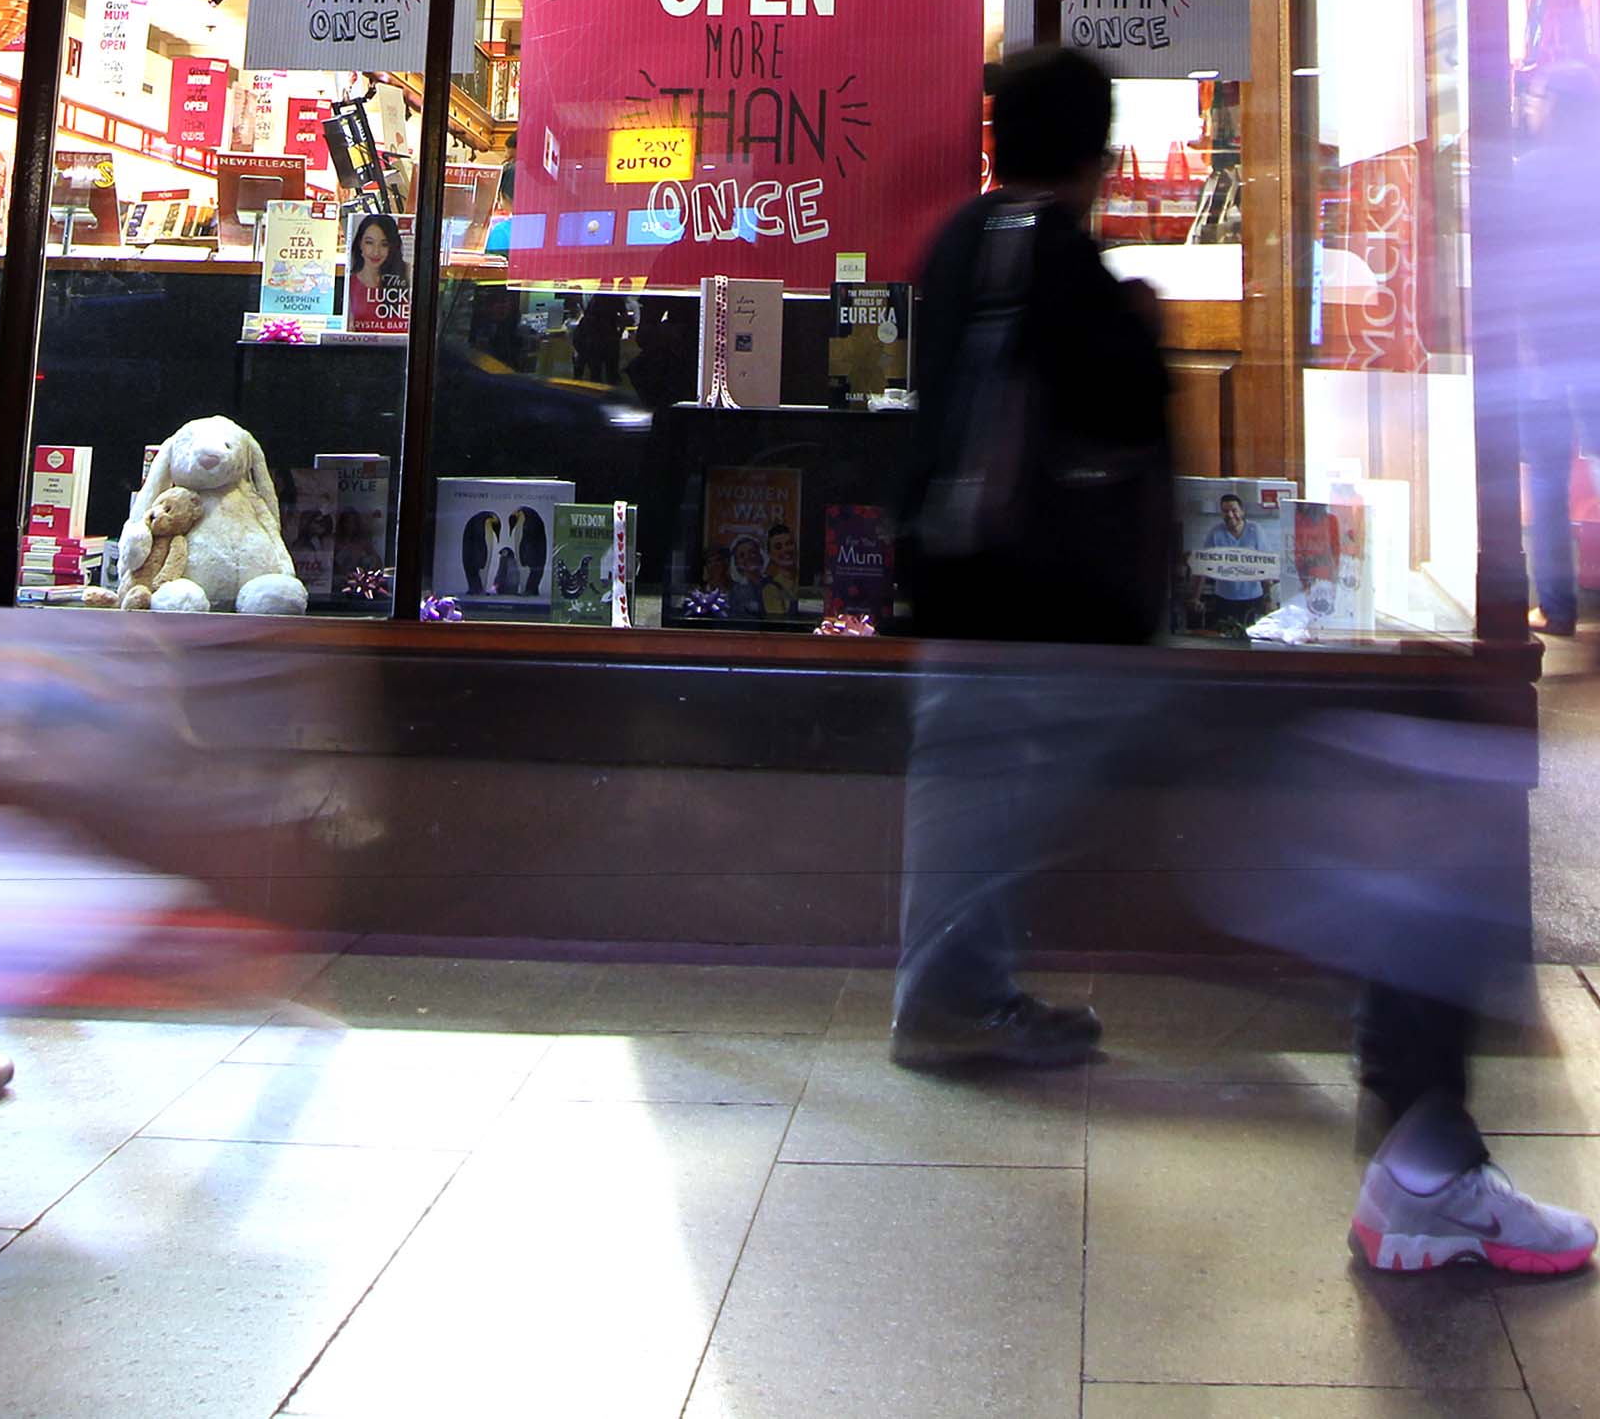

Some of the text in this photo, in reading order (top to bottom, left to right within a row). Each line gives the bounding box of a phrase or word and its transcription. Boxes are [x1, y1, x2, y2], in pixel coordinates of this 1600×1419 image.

[104, 10, 129, 20] MUM
[309, 10, 401, 42] ONCE
[1072, 15, 1170, 49] ONCE
[100, 40, 126, 50] OPEN
[705, 23, 785, 79] MORE
[184, 101, 208, 112] OPEN
[659, 87, 827, 164] THAN
[296, 133, 317, 142] OPEN
[220, 156, 301, 169] NEW RELEASE
[444, 170, 497, 179] RELEASE
[648, 179, 828, 244] ONCE
[289, 237, 314, 247] TEA
[279, 248, 323, 259] CHEST
[382, 274, 407, 287] The
[274, 295, 320, 304] JOSEPHINE
[366, 288, 411, 304] LUCK
[283, 303, 312, 311] MOON
[375, 303, 410, 319] ONE
[840, 306, 898, 324] EUREKA
[717, 485, 790, 501] WOMEN
[571, 513, 607, 527] WISDOM
[837, 546, 883, 565] Mum
[1224, 553, 1240, 562] FOR
[1241, 554, 1276, 565] EVERYONE
